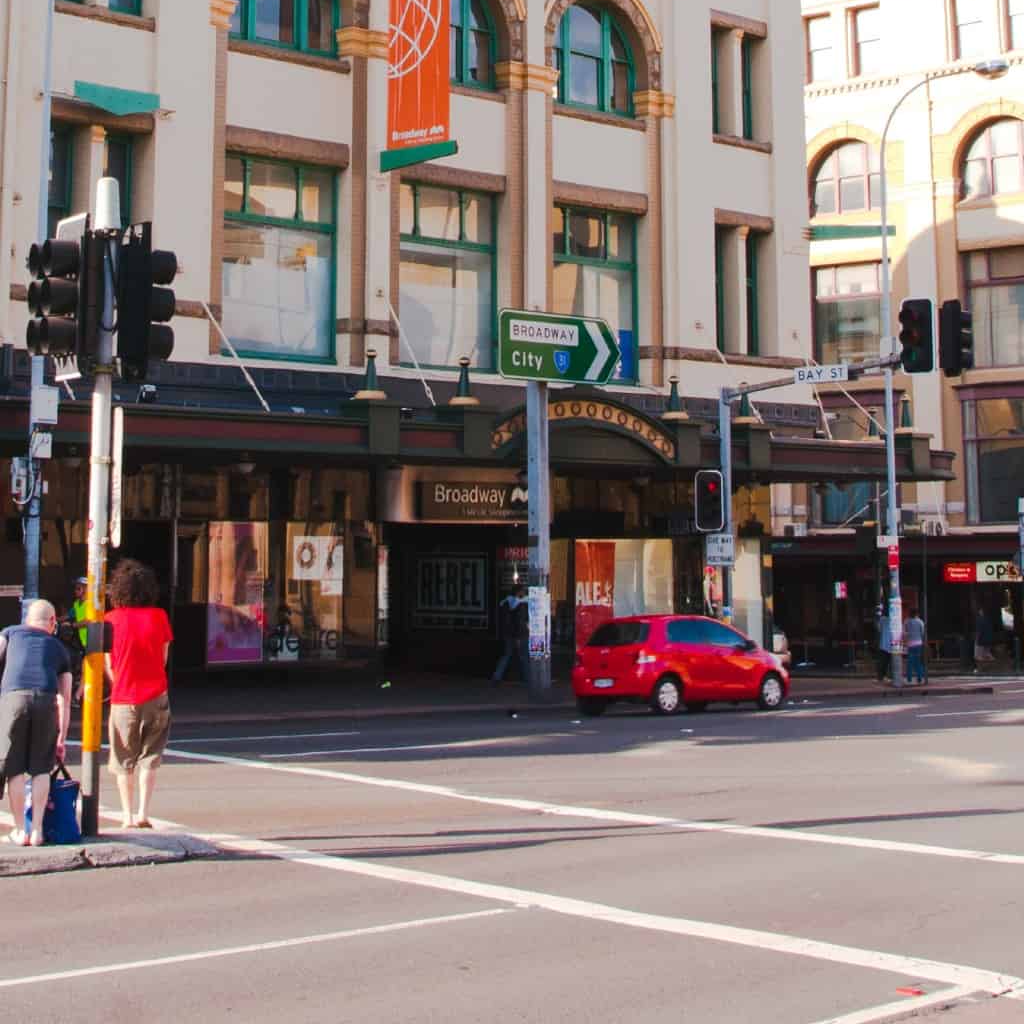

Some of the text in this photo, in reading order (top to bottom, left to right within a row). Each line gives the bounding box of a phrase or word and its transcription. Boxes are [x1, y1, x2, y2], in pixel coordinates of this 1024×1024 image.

[512, 324, 575, 341] BROADWAY
[511, 350, 543, 372] City
[798, 367, 844, 381] BAY ST
[434, 483, 506, 508] Broadway
